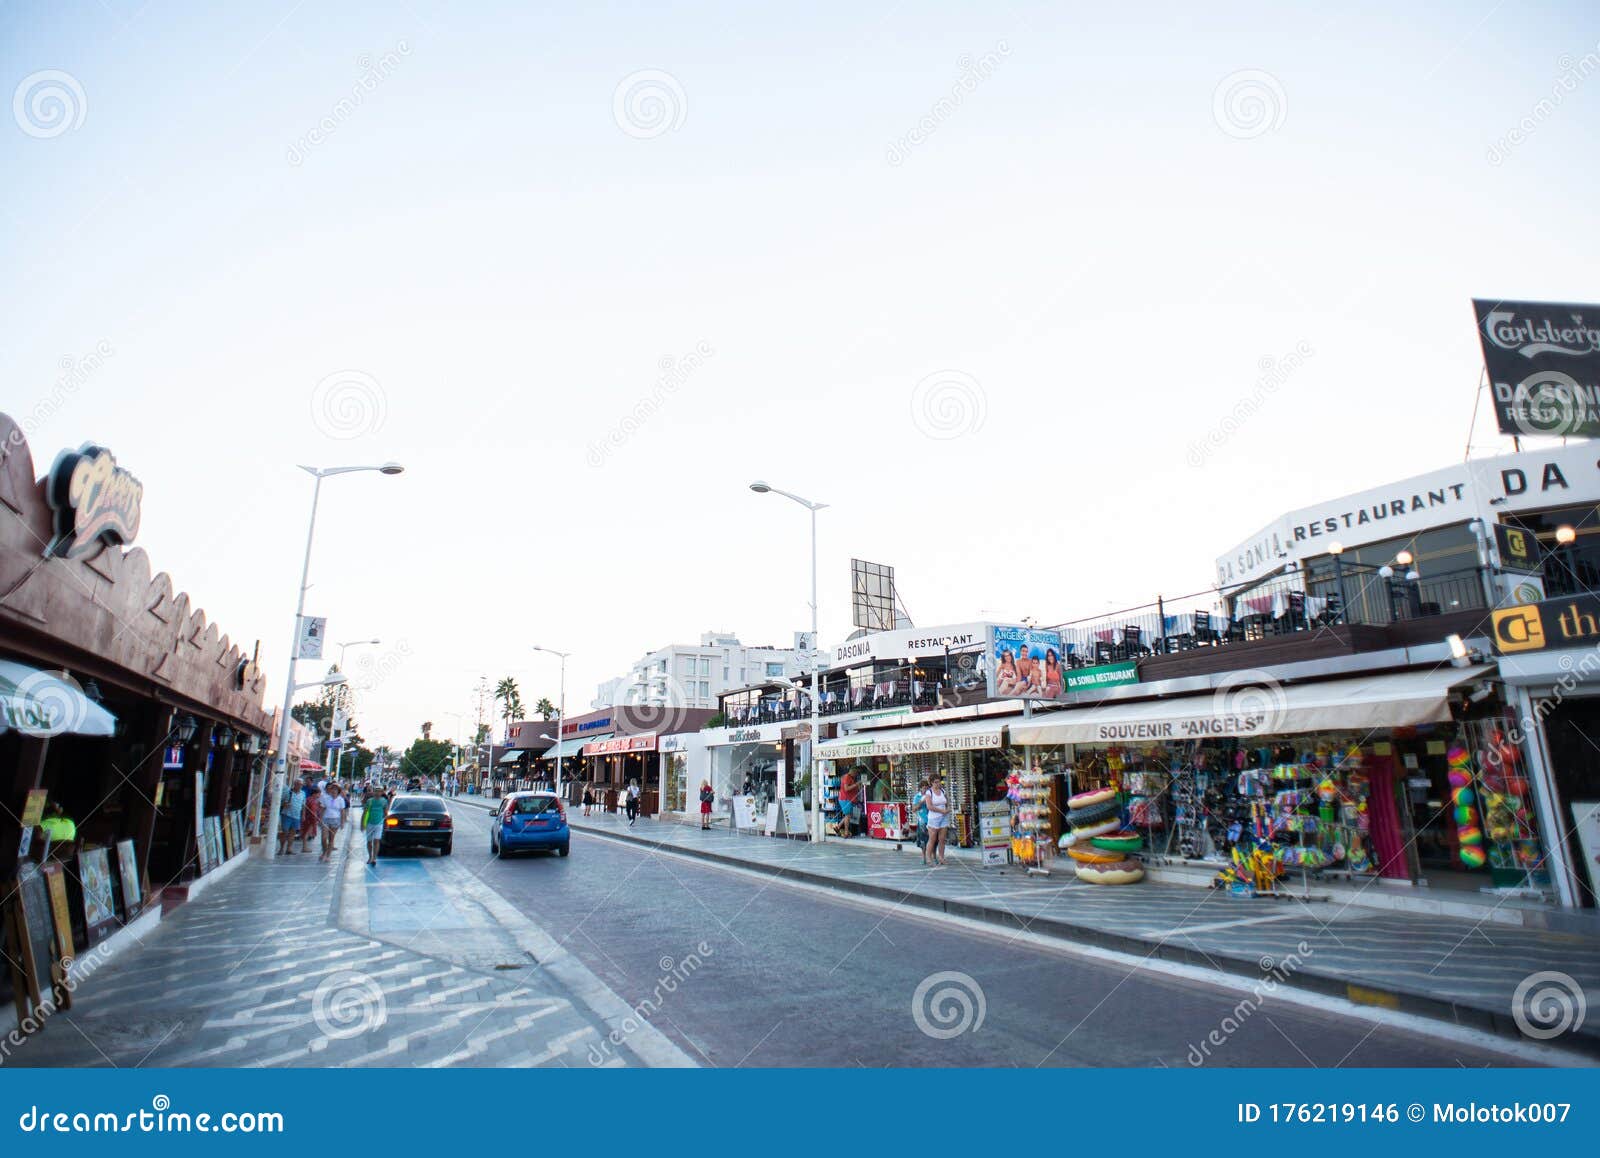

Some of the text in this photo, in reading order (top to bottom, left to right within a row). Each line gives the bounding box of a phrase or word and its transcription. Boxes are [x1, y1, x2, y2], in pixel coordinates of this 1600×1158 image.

[1486, 311, 1600, 352] Carlsberg
[1495, 382, 1533, 402] DA
[1500, 462, 1569, 497] DA
[1293, 483, 1465, 541] RESTAURANT
[1558, 602, 1600, 638] th
[908, 634, 973, 649] RESTAUANT
[1096, 669, 1135, 683] RESTAURANT
[1100, 722, 1172, 739] SOUVENIR
